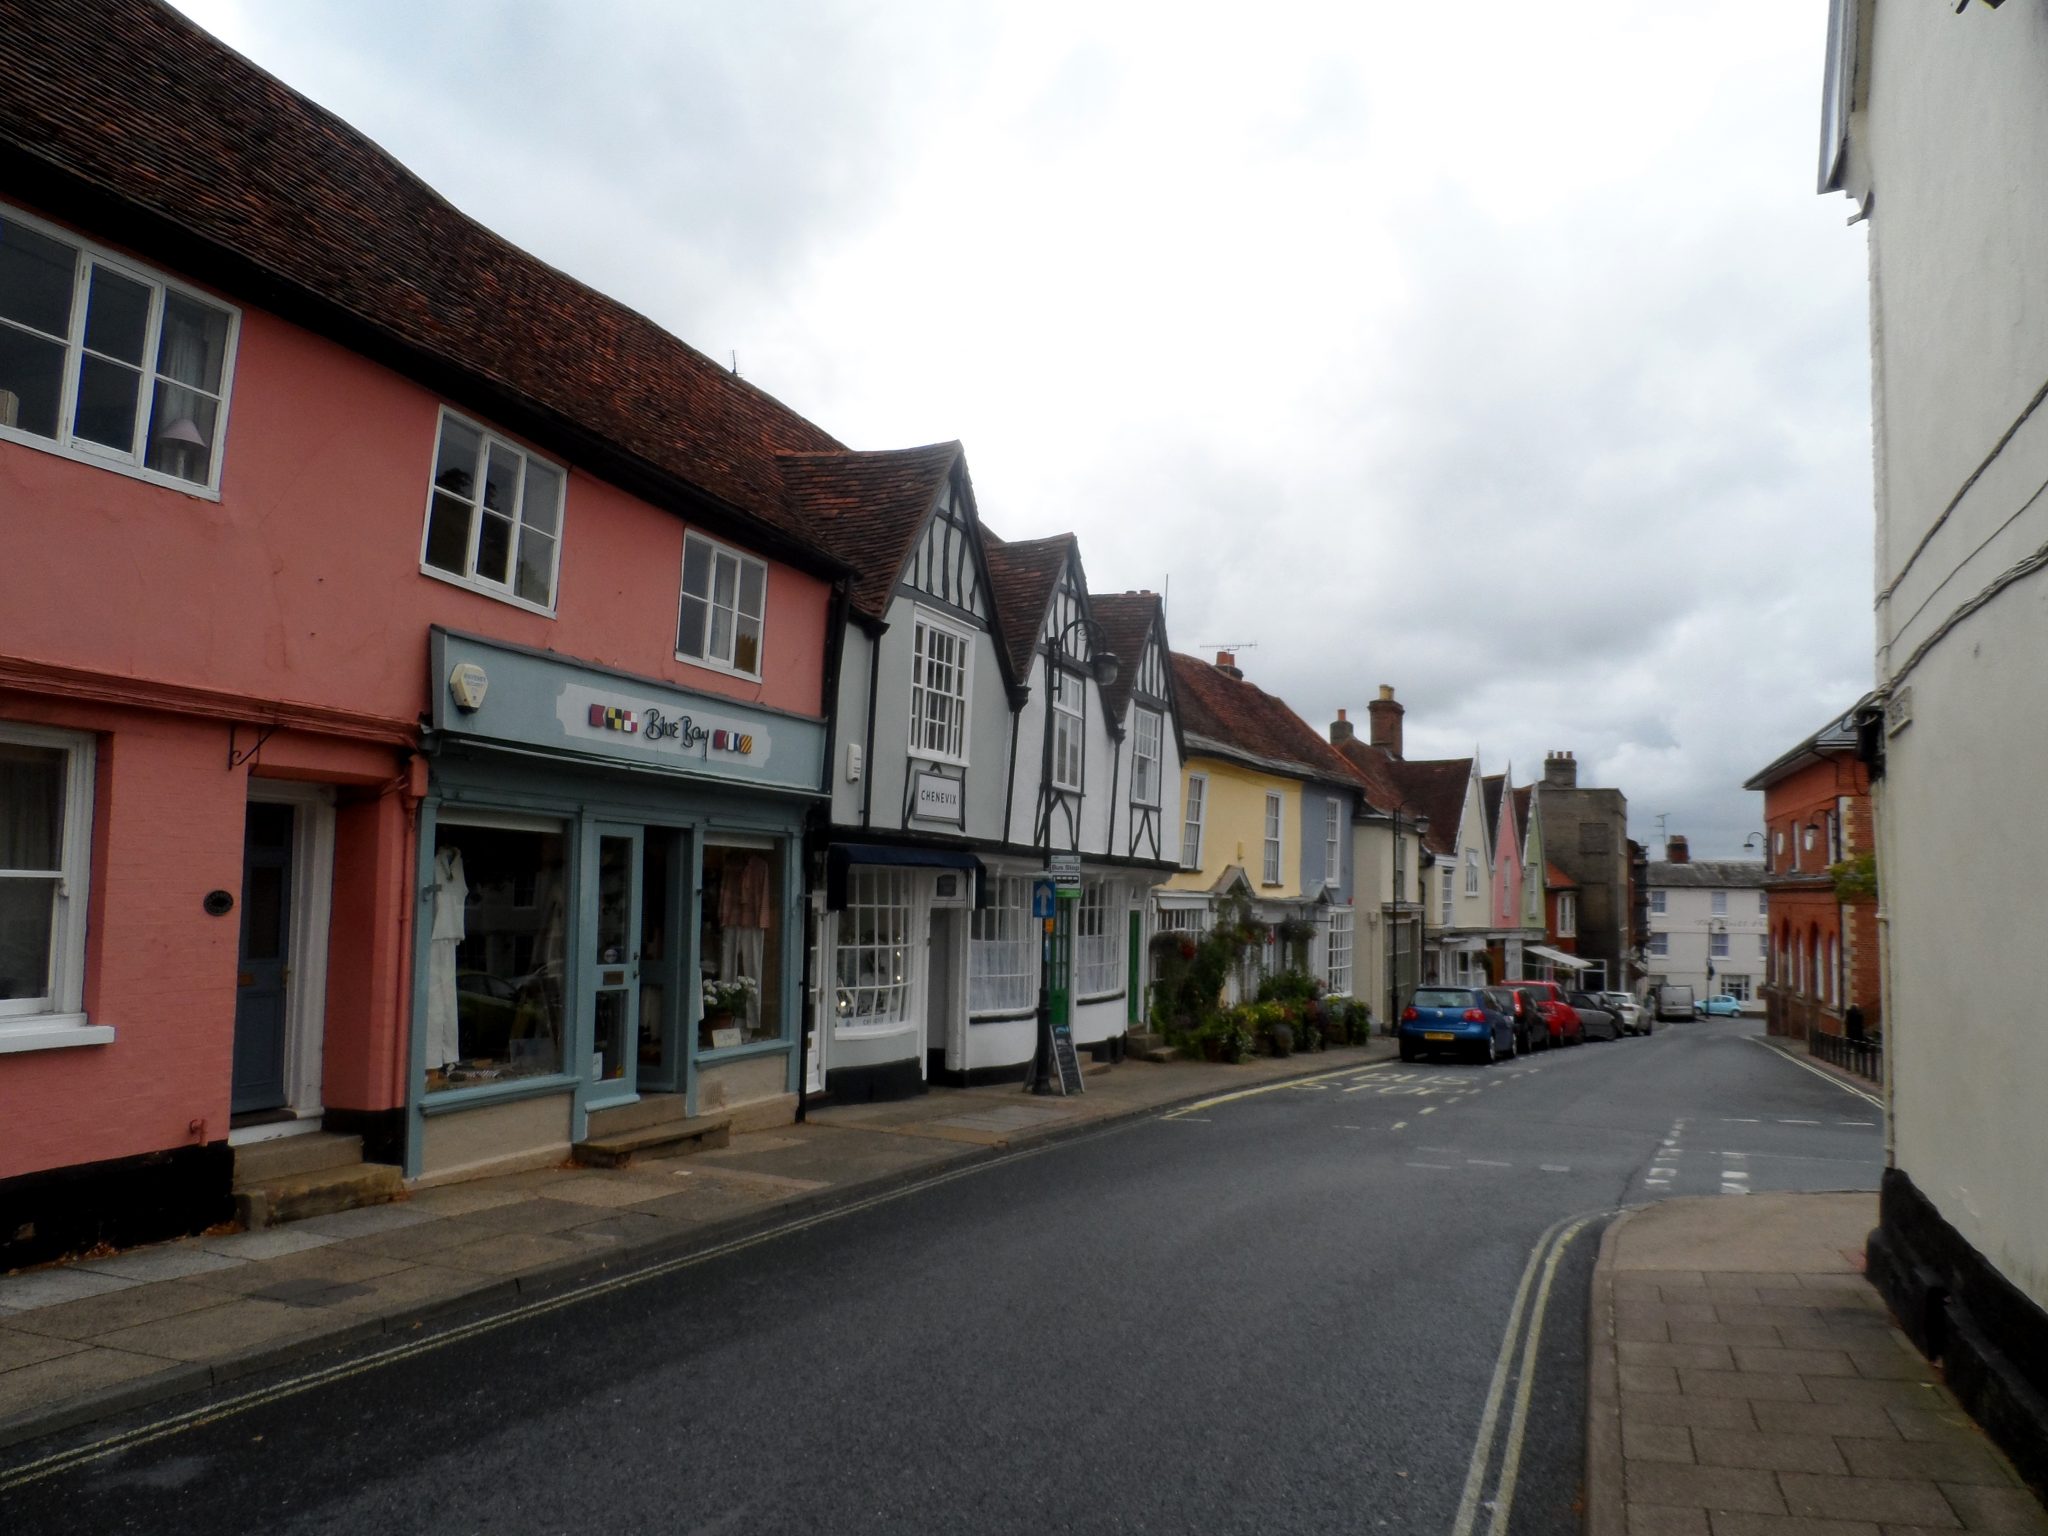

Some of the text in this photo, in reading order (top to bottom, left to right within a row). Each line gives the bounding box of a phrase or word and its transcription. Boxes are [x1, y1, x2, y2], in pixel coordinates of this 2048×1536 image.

[644, 708, 709, 763] Blue Bay
[921, 790, 957, 805] CHENEVIX
[1065, 864, 1080, 872] Stop
